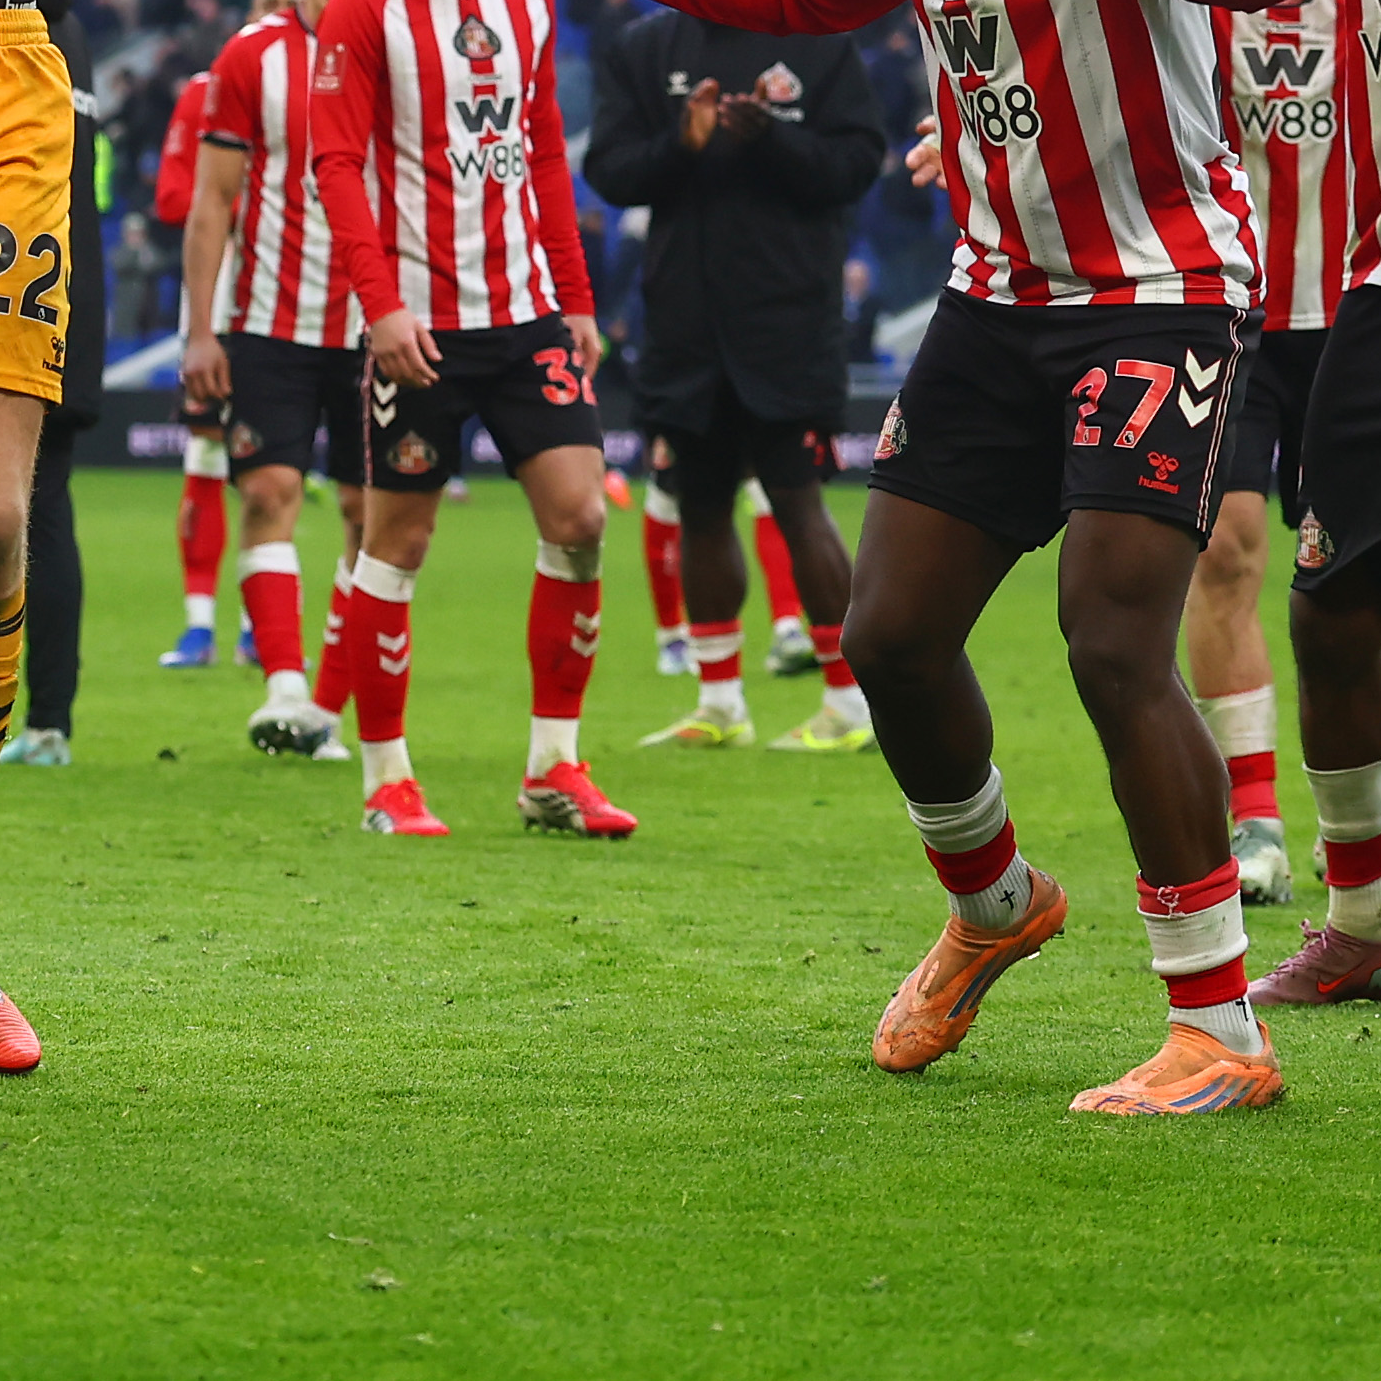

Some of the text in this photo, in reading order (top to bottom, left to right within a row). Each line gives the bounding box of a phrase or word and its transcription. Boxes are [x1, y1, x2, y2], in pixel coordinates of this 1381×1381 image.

[957, 84, 1039, 143] W88
[1234, 99, 1334, 138] W88
[450, 143, 524, 179] W88
[1072, 359, 1175, 449] 27
